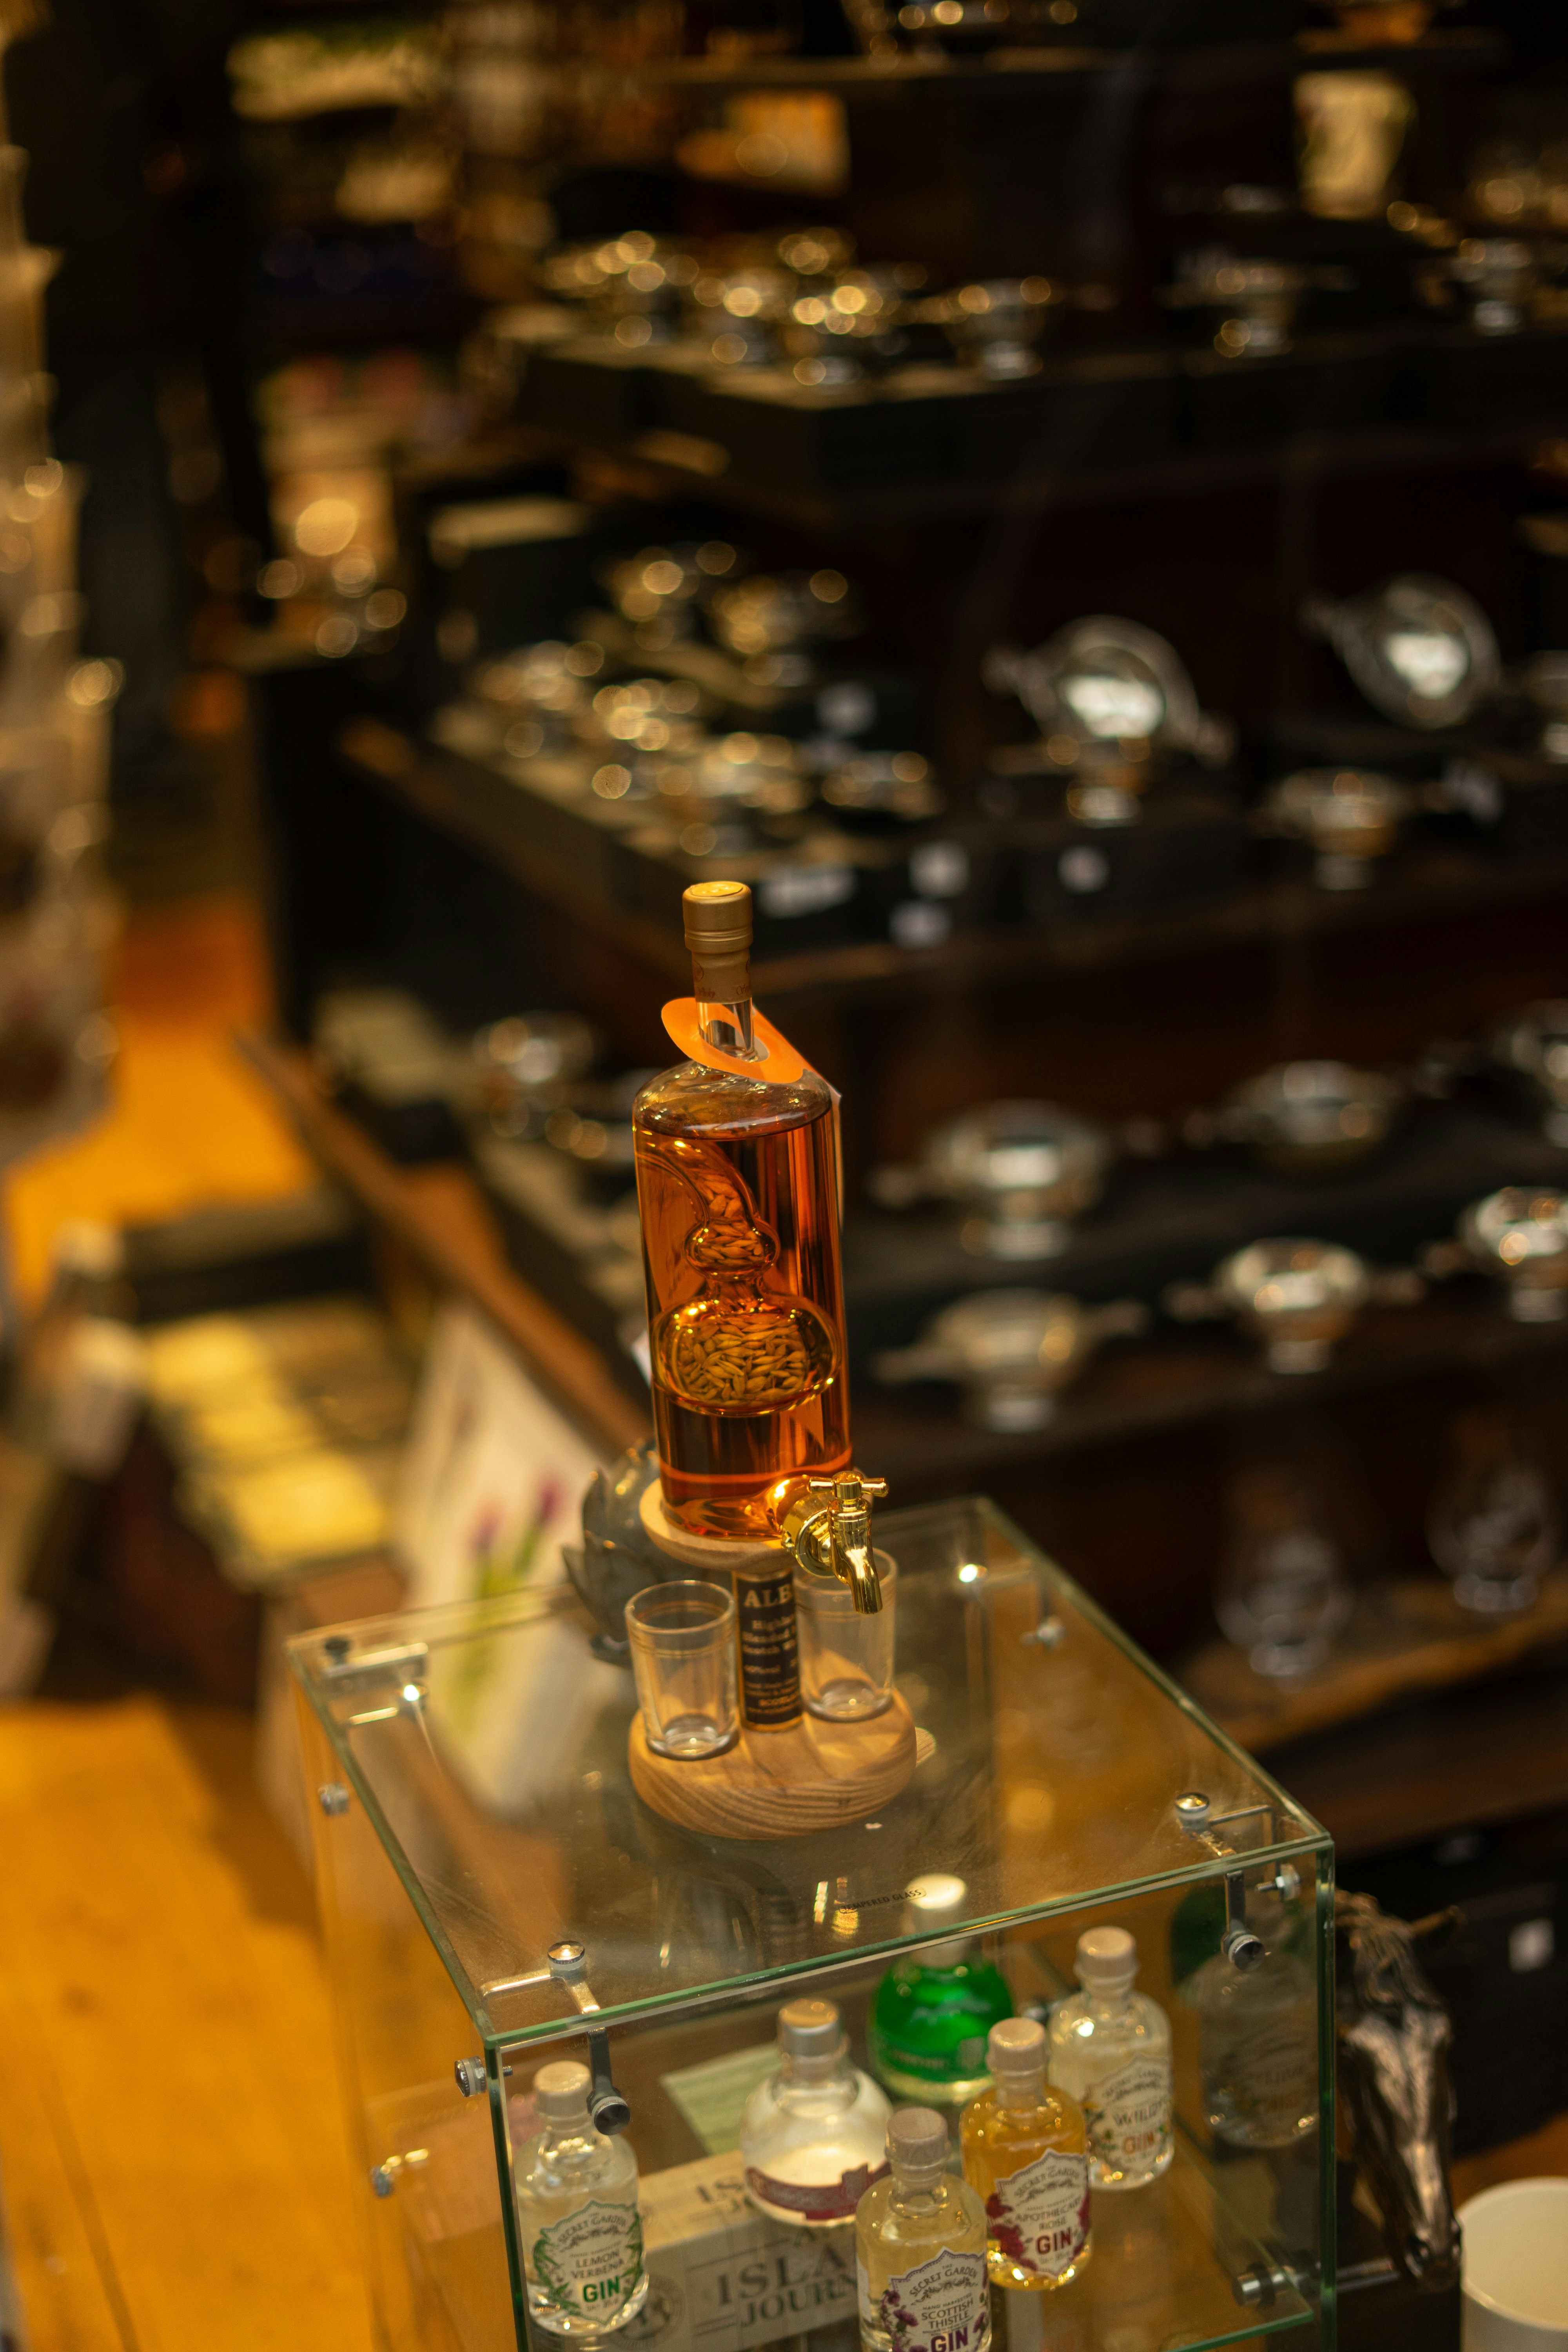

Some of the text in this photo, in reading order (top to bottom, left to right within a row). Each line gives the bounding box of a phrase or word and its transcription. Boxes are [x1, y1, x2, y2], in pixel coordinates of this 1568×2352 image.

[892, 1889, 921, 1901] GLASS
[1036, 2227, 1071, 2255] GIN
[571, 2257, 625, 2279] VERBENA
[575, 2248, 620, 2269] LEMON
[718, 2242, 848, 2306] ISLA
[909, 2266, 978, 2297] SECRET GARDEN
[583, 2275, 621, 2303] GIN
[740, 2274, 857, 2328] JOUR
[922, 2297, 974, 2321] SCOTTISH
[928, 2310, 970, 2329] THISTLE
[931, 2326, 968, 2352] GIN
